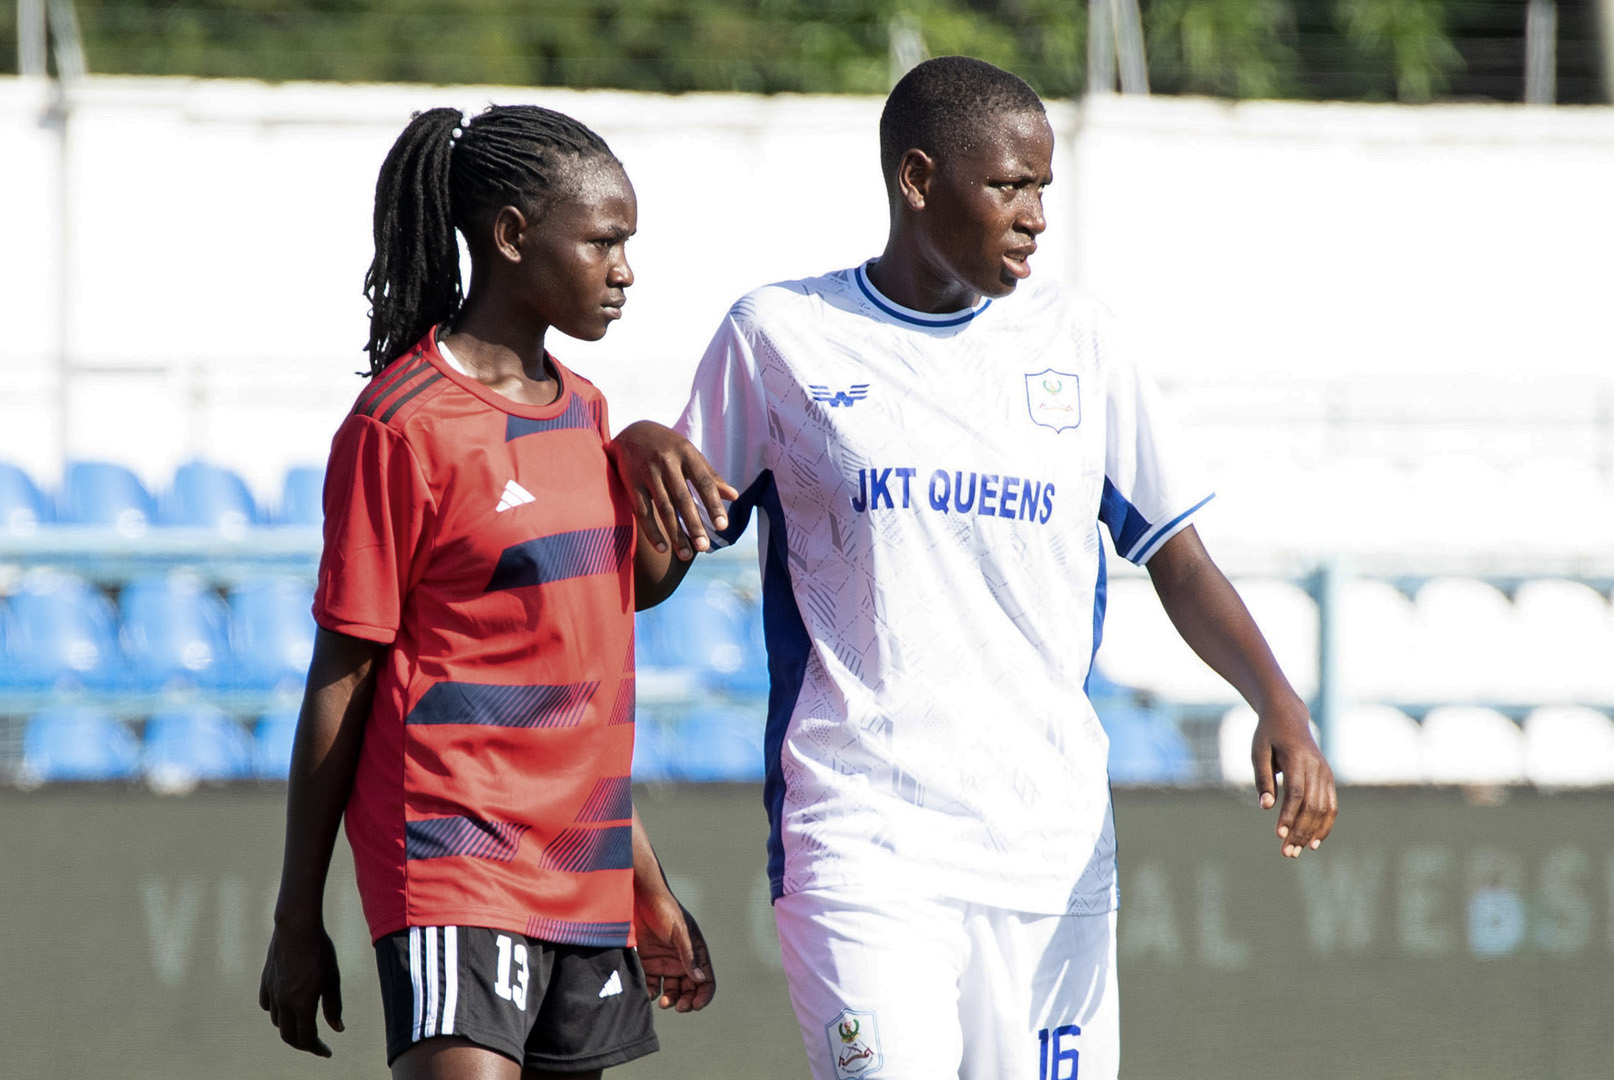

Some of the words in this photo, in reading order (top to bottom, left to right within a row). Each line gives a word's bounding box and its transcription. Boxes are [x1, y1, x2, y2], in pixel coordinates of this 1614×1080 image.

[851, 467, 916, 513] JKT
[928, 468, 1056, 525] QUEENS
[1297, 843, 1614, 960] WEBS
[494, 934, 530, 1012] 13
[1038, 1024, 1082, 1080] 16
